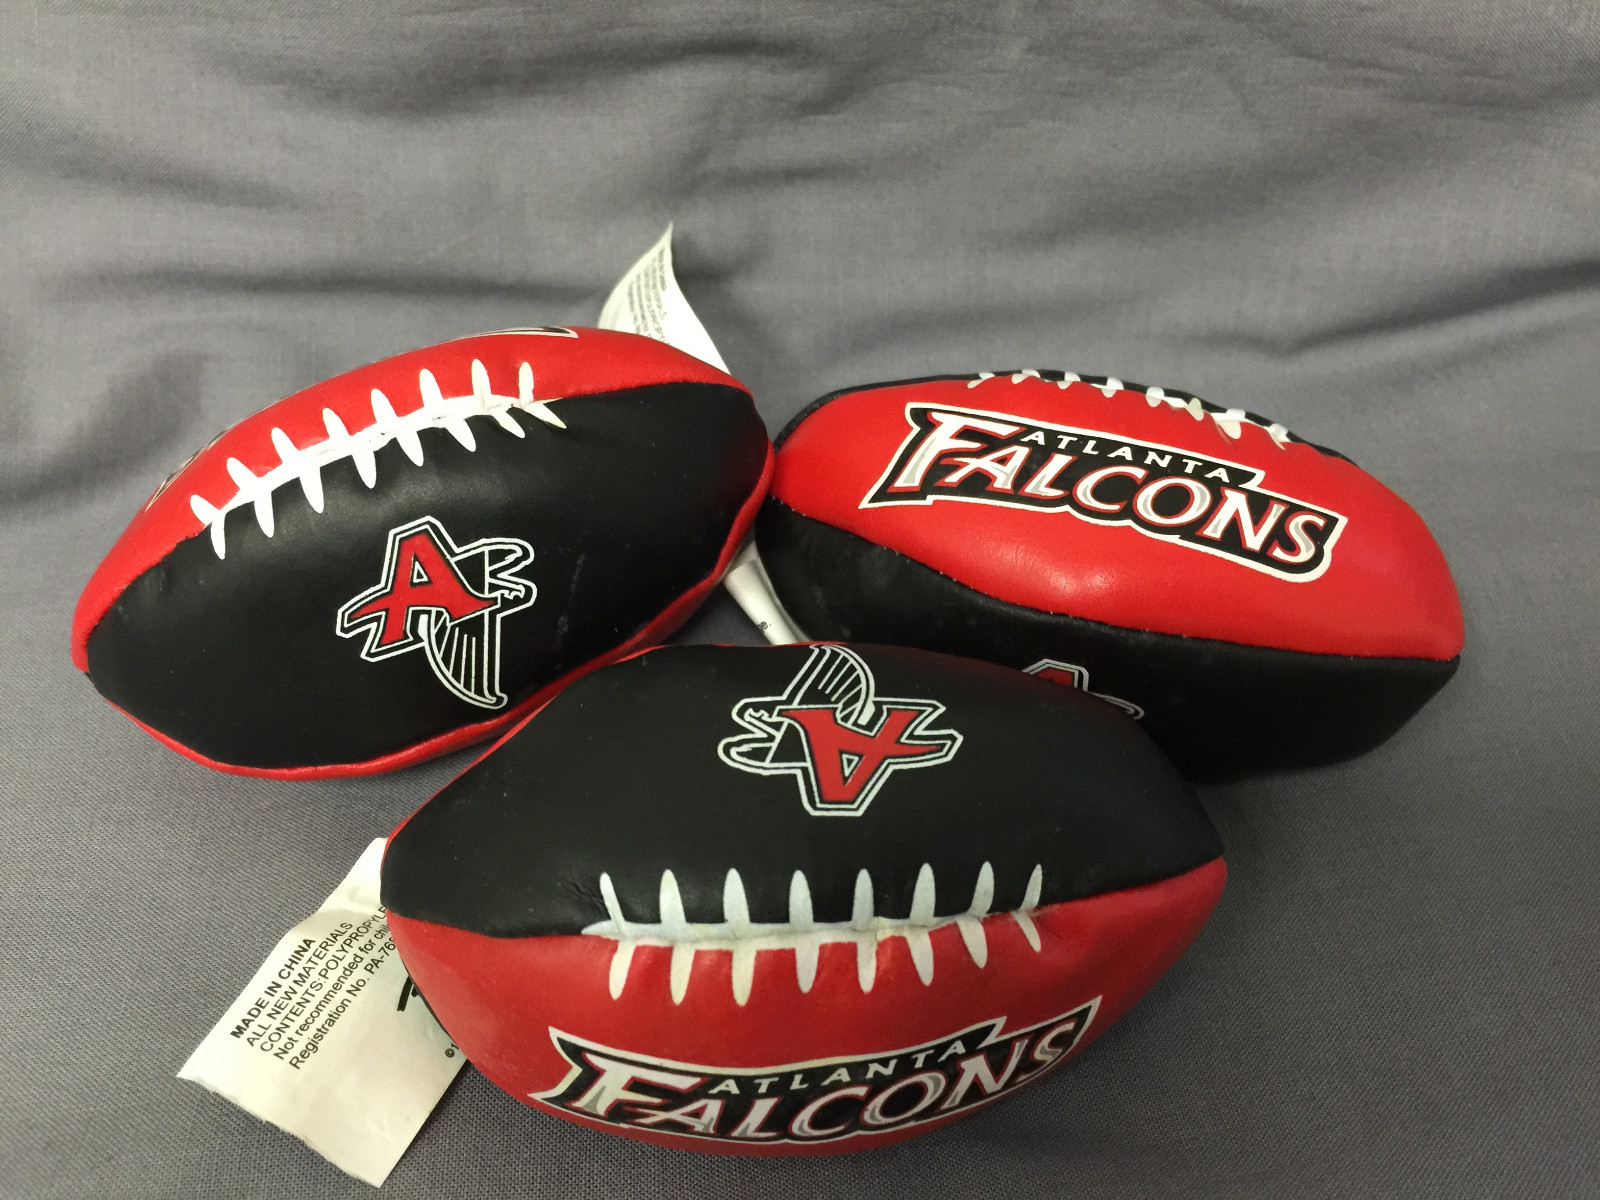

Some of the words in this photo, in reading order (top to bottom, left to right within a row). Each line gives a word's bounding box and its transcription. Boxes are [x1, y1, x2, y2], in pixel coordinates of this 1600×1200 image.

[887, 410, 1329, 565] FALCONS
[1020, 430, 1230, 484] ATLANTA
[230, 997, 269, 1038] MADE
[264, 981, 282, 997] IN
[278, 939, 316, 979] CHINA
[246, 1023, 272, 1047] ALL
[266, 986, 297, 1020] NEW
[292, 922, 353, 987] MATERIALS
[273, 1036, 299, 1060] Not
[295, 953, 364, 1036] recommended
[358, 939, 376, 954] for
[288, 998, 352, 1069] Registration
[346, 978, 370, 997] No.
[570, 1018, 1077, 1139] FALCONS
[707, 1039, 967, 1095] ATLANTA
